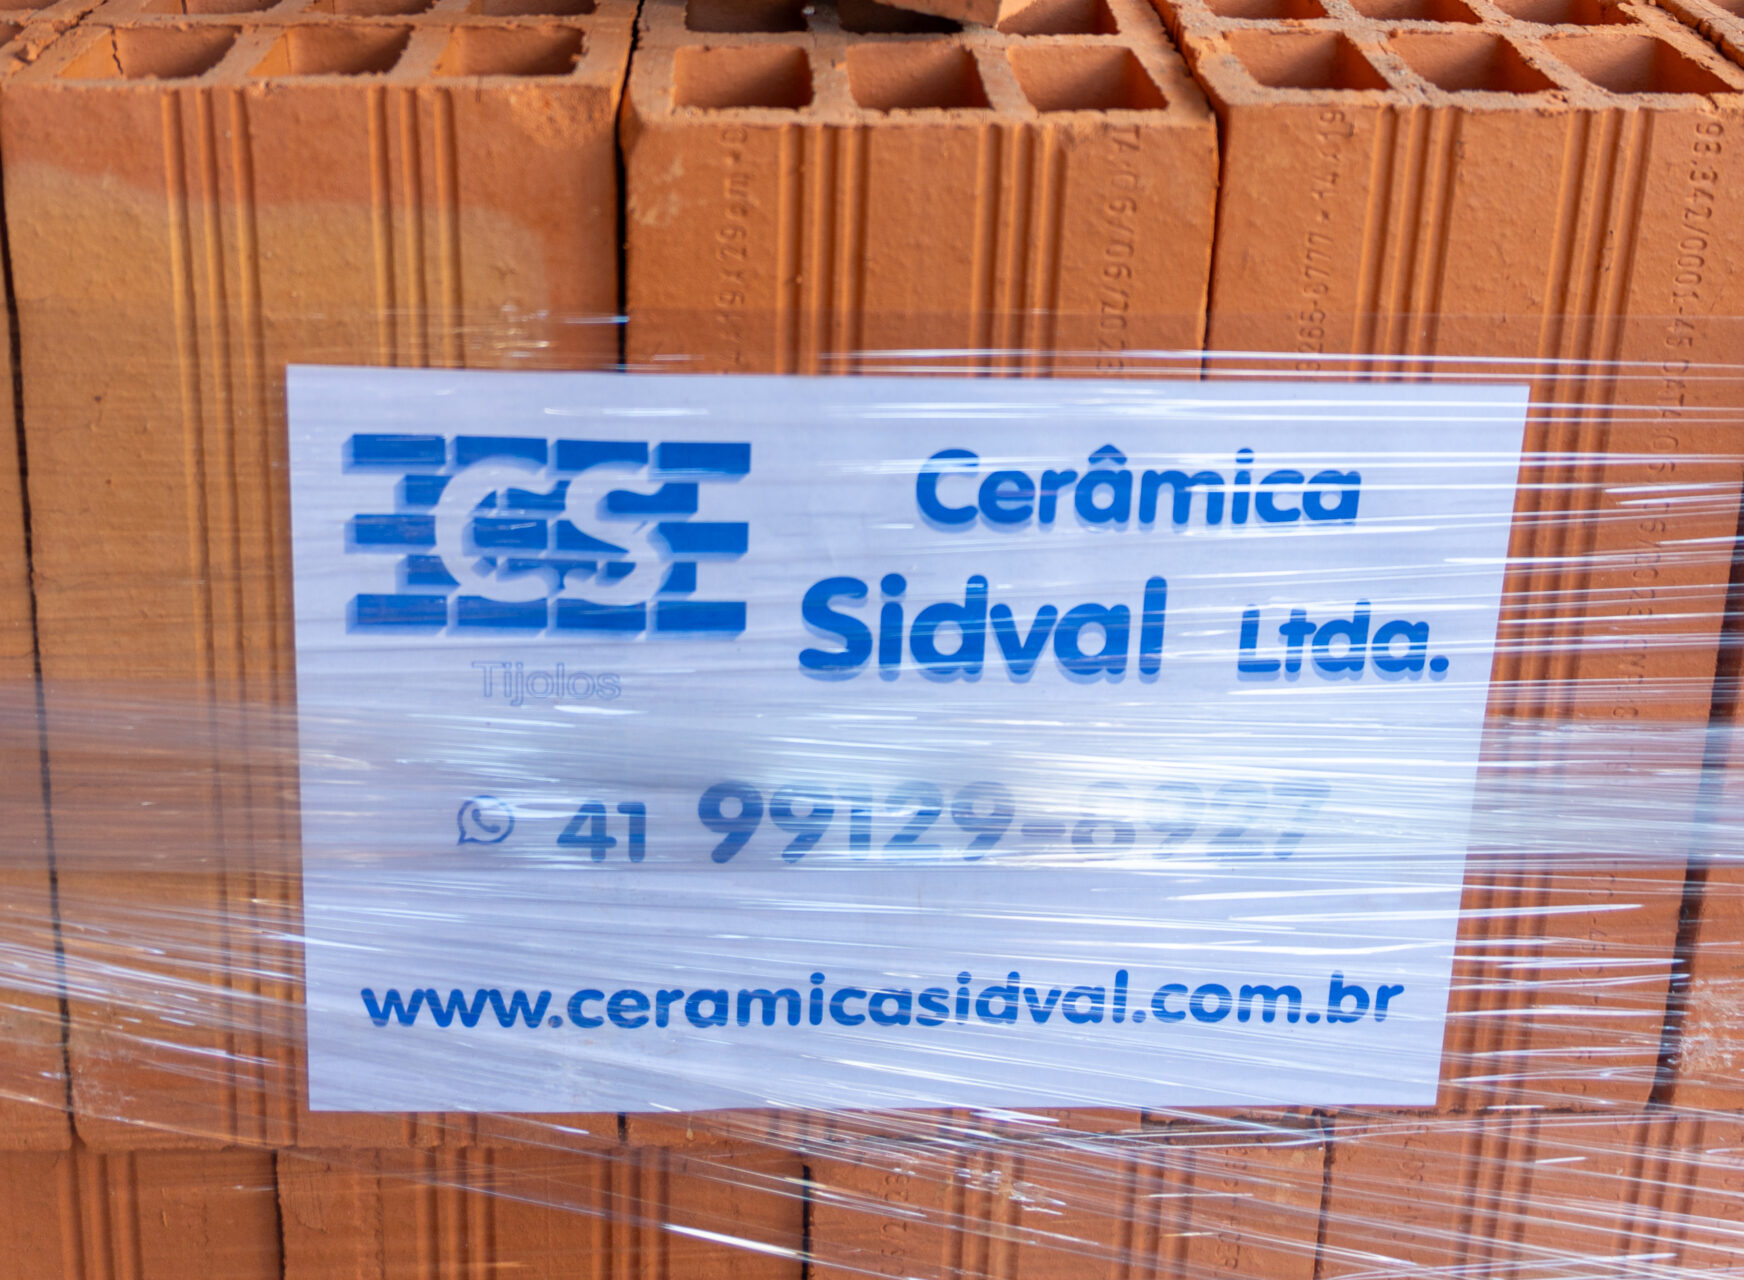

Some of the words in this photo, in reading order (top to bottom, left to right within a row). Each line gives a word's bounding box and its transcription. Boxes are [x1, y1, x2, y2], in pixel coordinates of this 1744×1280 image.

[915, 444, 1362, 526] Cerâmica
[798, 572, 1168, 680] Sidval
[1236, 600, 1450, 676] Ltda.
[471, 661, 622, 707] Tijolos
[556, 802, 647, 863] 41
[360, 969, 1405, 1029] www.ceramicasidval.com.br
